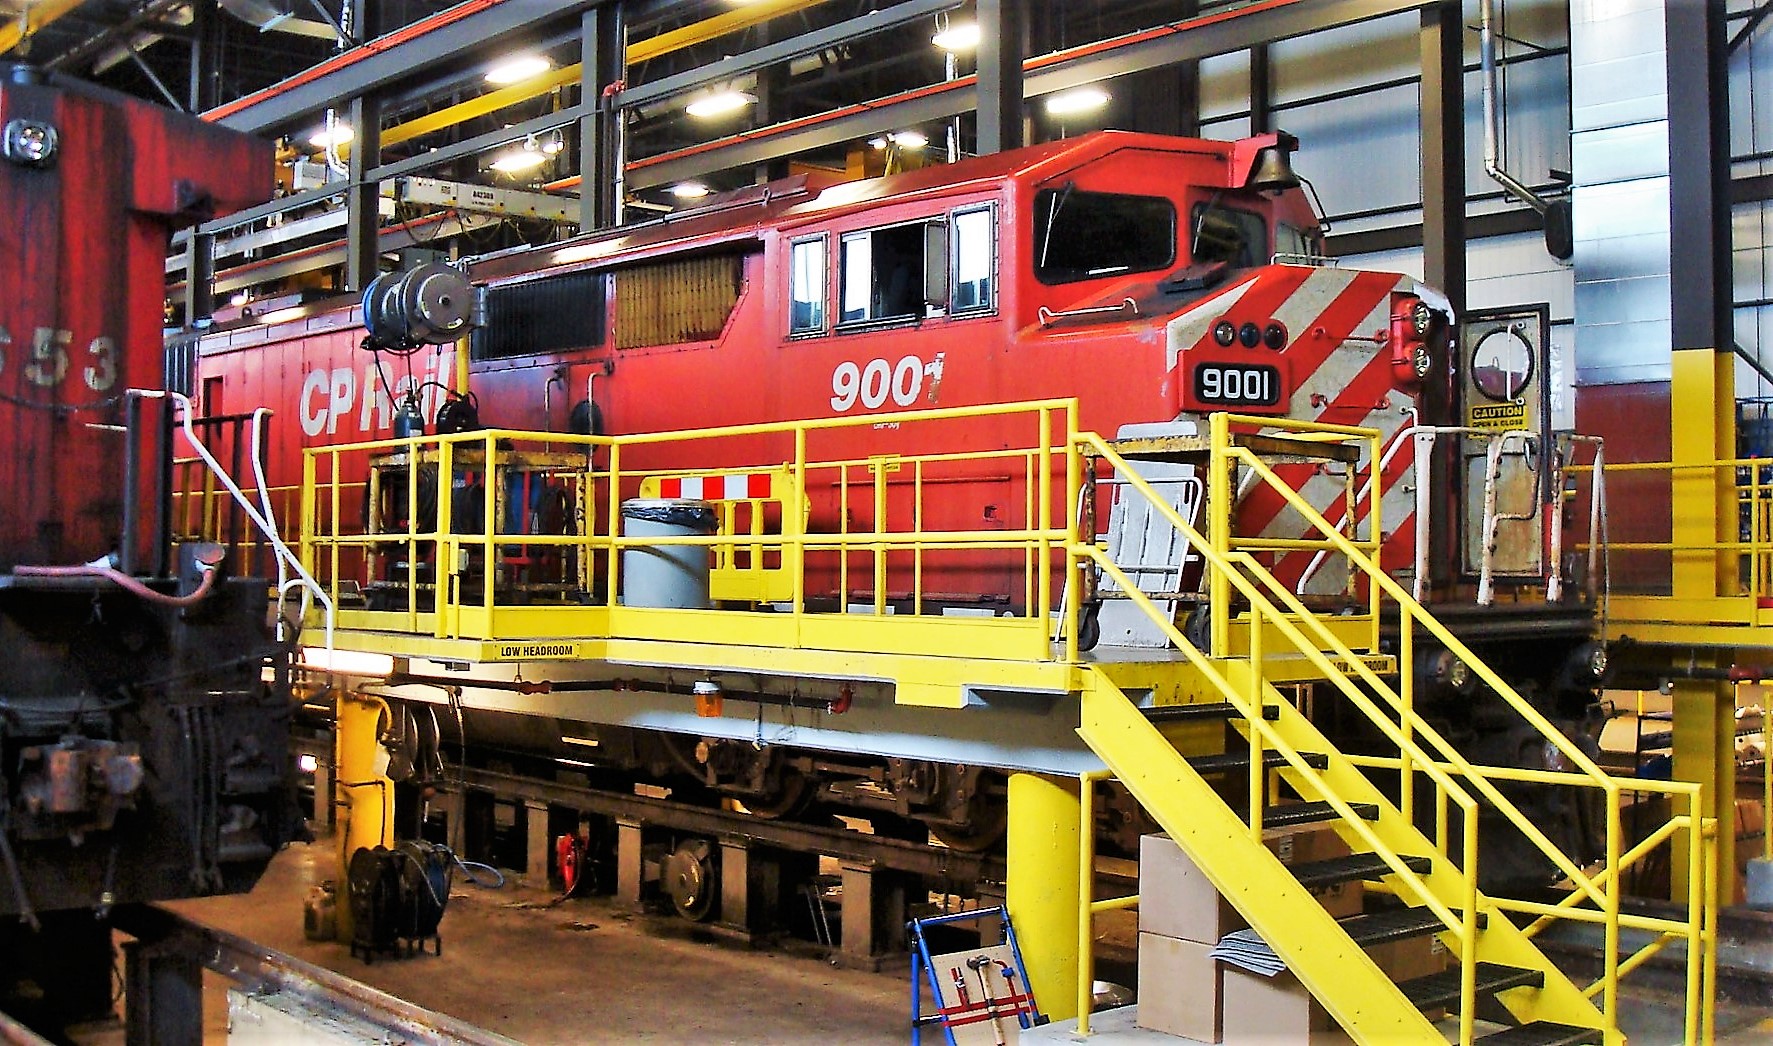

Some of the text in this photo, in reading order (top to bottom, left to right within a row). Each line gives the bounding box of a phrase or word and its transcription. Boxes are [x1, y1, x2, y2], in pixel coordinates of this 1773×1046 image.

[0, 325, 117, 391] 53
[300, 367, 357, 437] CP
[830, 352, 946, 412] 9001
[1203, 368, 1269, 400] 9001
[1474, 406, 1522, 418] CAUTION
[501, 645, 573, 657] LOW HEADROOM
